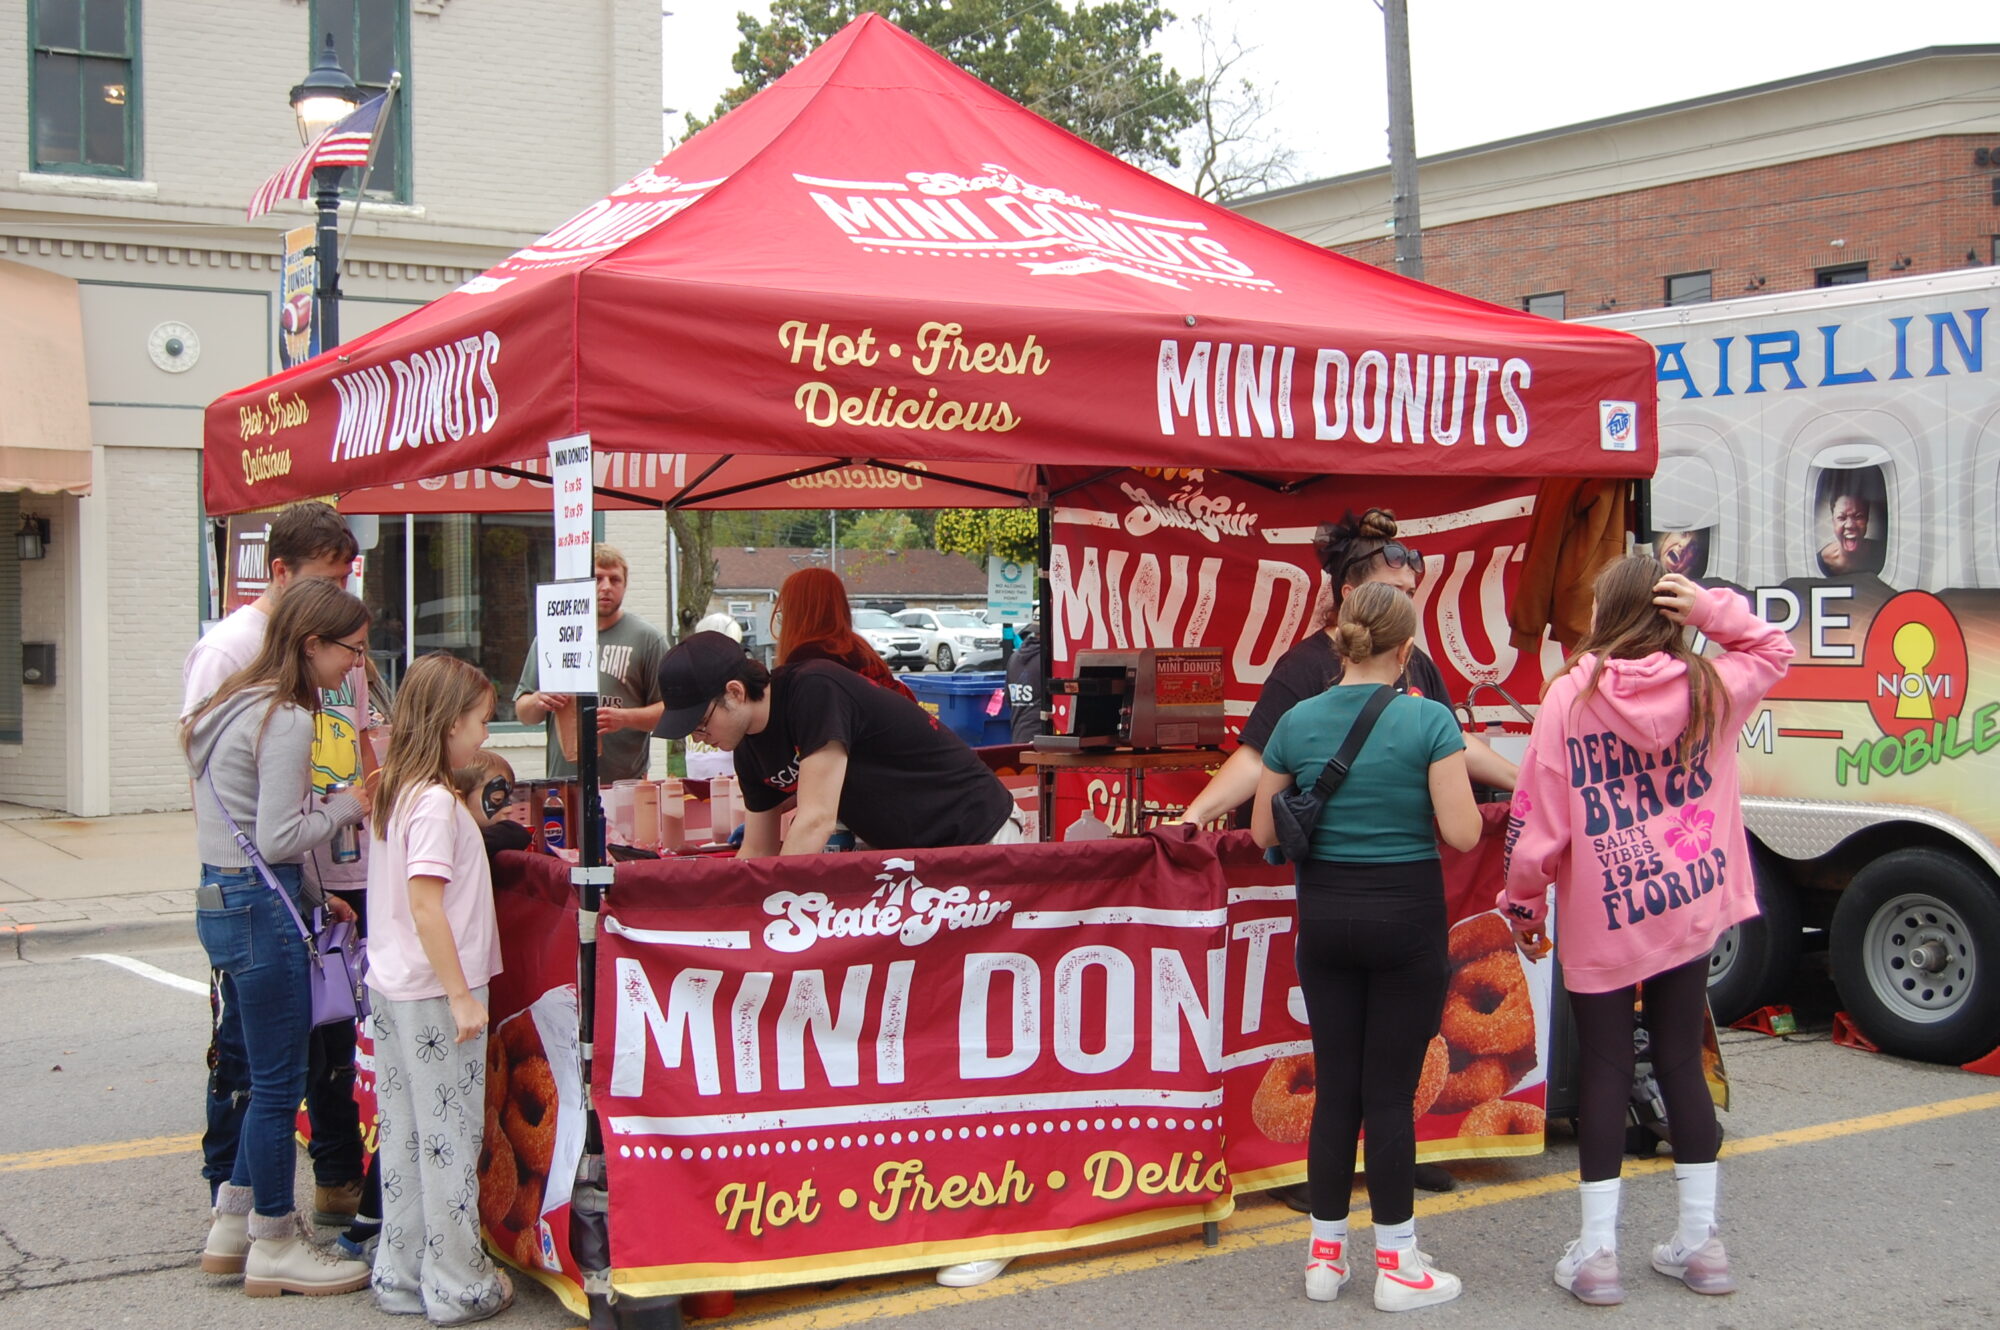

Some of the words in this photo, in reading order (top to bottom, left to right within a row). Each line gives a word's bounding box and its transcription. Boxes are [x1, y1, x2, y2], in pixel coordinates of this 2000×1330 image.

[809, 191, 999, 241] MINI
[998, 195, 1254, 277] DONUTS
[288, 264, 312, 294] JUNGLE
[778, 320, 880, 372] Hot
[911, 321, 1050, 376] Fresh
[331, 365, 391, 463] MINI
[388, 330, 500, 452] DONUTS
[794, 381, 1021, 433] Delicious
[1156, 339, 1295, 438] MINI
[1312, 348, 1531, 448] DONUTS
[240, 404, 264, 441] Hot
[267, 391, 310, 435] Fresh
[242, 444, 292, 486] Delicious
[555, 449, 568, 467] MINI
[568, 446, 589, 465] DONUTS
[564, 480, 568, 493] 6
[564, 505, 569, 518] 12
[576, 503, 583, 518] $9
[1189, 496, 1258, 543] Fair
[238, 544, 265, 579] MINI
[547, 599, 571, 617] ESCAPE
[571, 597, 590, 614] ROOM
[1050, 543, 1224, 662] MINI
[559, 627, 575, 643] SIGN
[575, 625, 583, 641] UP
[562, 652, 581, 669] HERE!!
[1157, 662, 1181, 673] MINI
[1183, 661, 1222, 673] DONUTS
[1877, 672, 1951, 699] NOVI
[1836, 702, 2000, 787] MOBILE
[1593, 825, 1647, 853] SALTY
[1597, 840, 1654, 868] VIBES
[1602, 852, 1664, 892] 1925
[762, 890, 901, 953] State
[899, 886, 1013, 947] Fair
[610, 957, 916, 1098] MINI
[714, 1178, 821, 1237] Hot
[868, 1157, 1035, 1224] Fresh
[1319, 1247, 1335, 1255] NIKE
